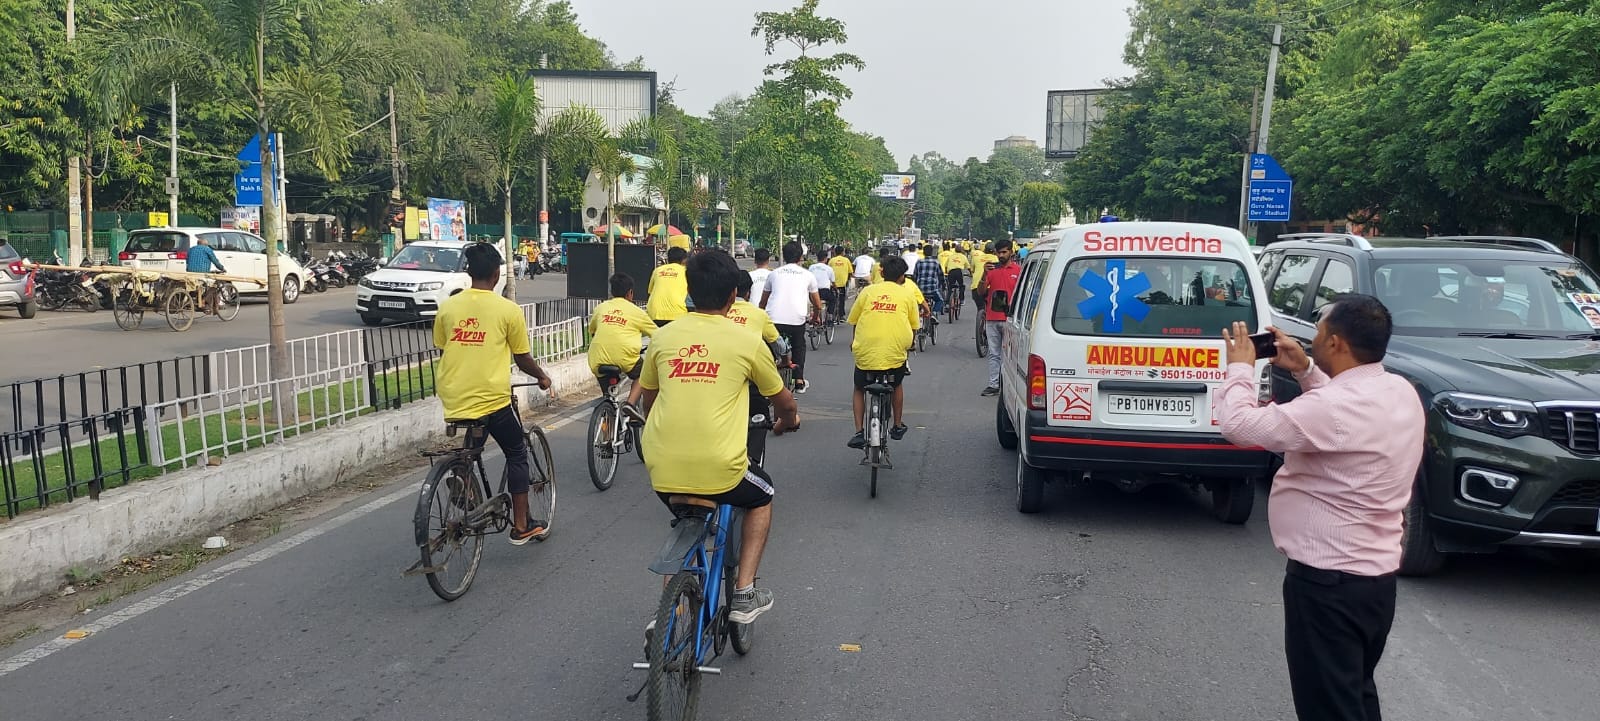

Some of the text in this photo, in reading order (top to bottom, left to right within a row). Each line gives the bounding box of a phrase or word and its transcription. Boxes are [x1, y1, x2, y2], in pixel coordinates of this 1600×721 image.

[1083, 231, 1222, 254] Samvedna
[870, 301, 898, 312] AVON
[601, 314, 628, 327] AVON
[450, 328, 487, 343] AVON
[1087, 345, 1219, 368] AMBULANCE
[668, 358, 720, 379] AVON
[1117, 398, 1191, 412] PB10HV8305
